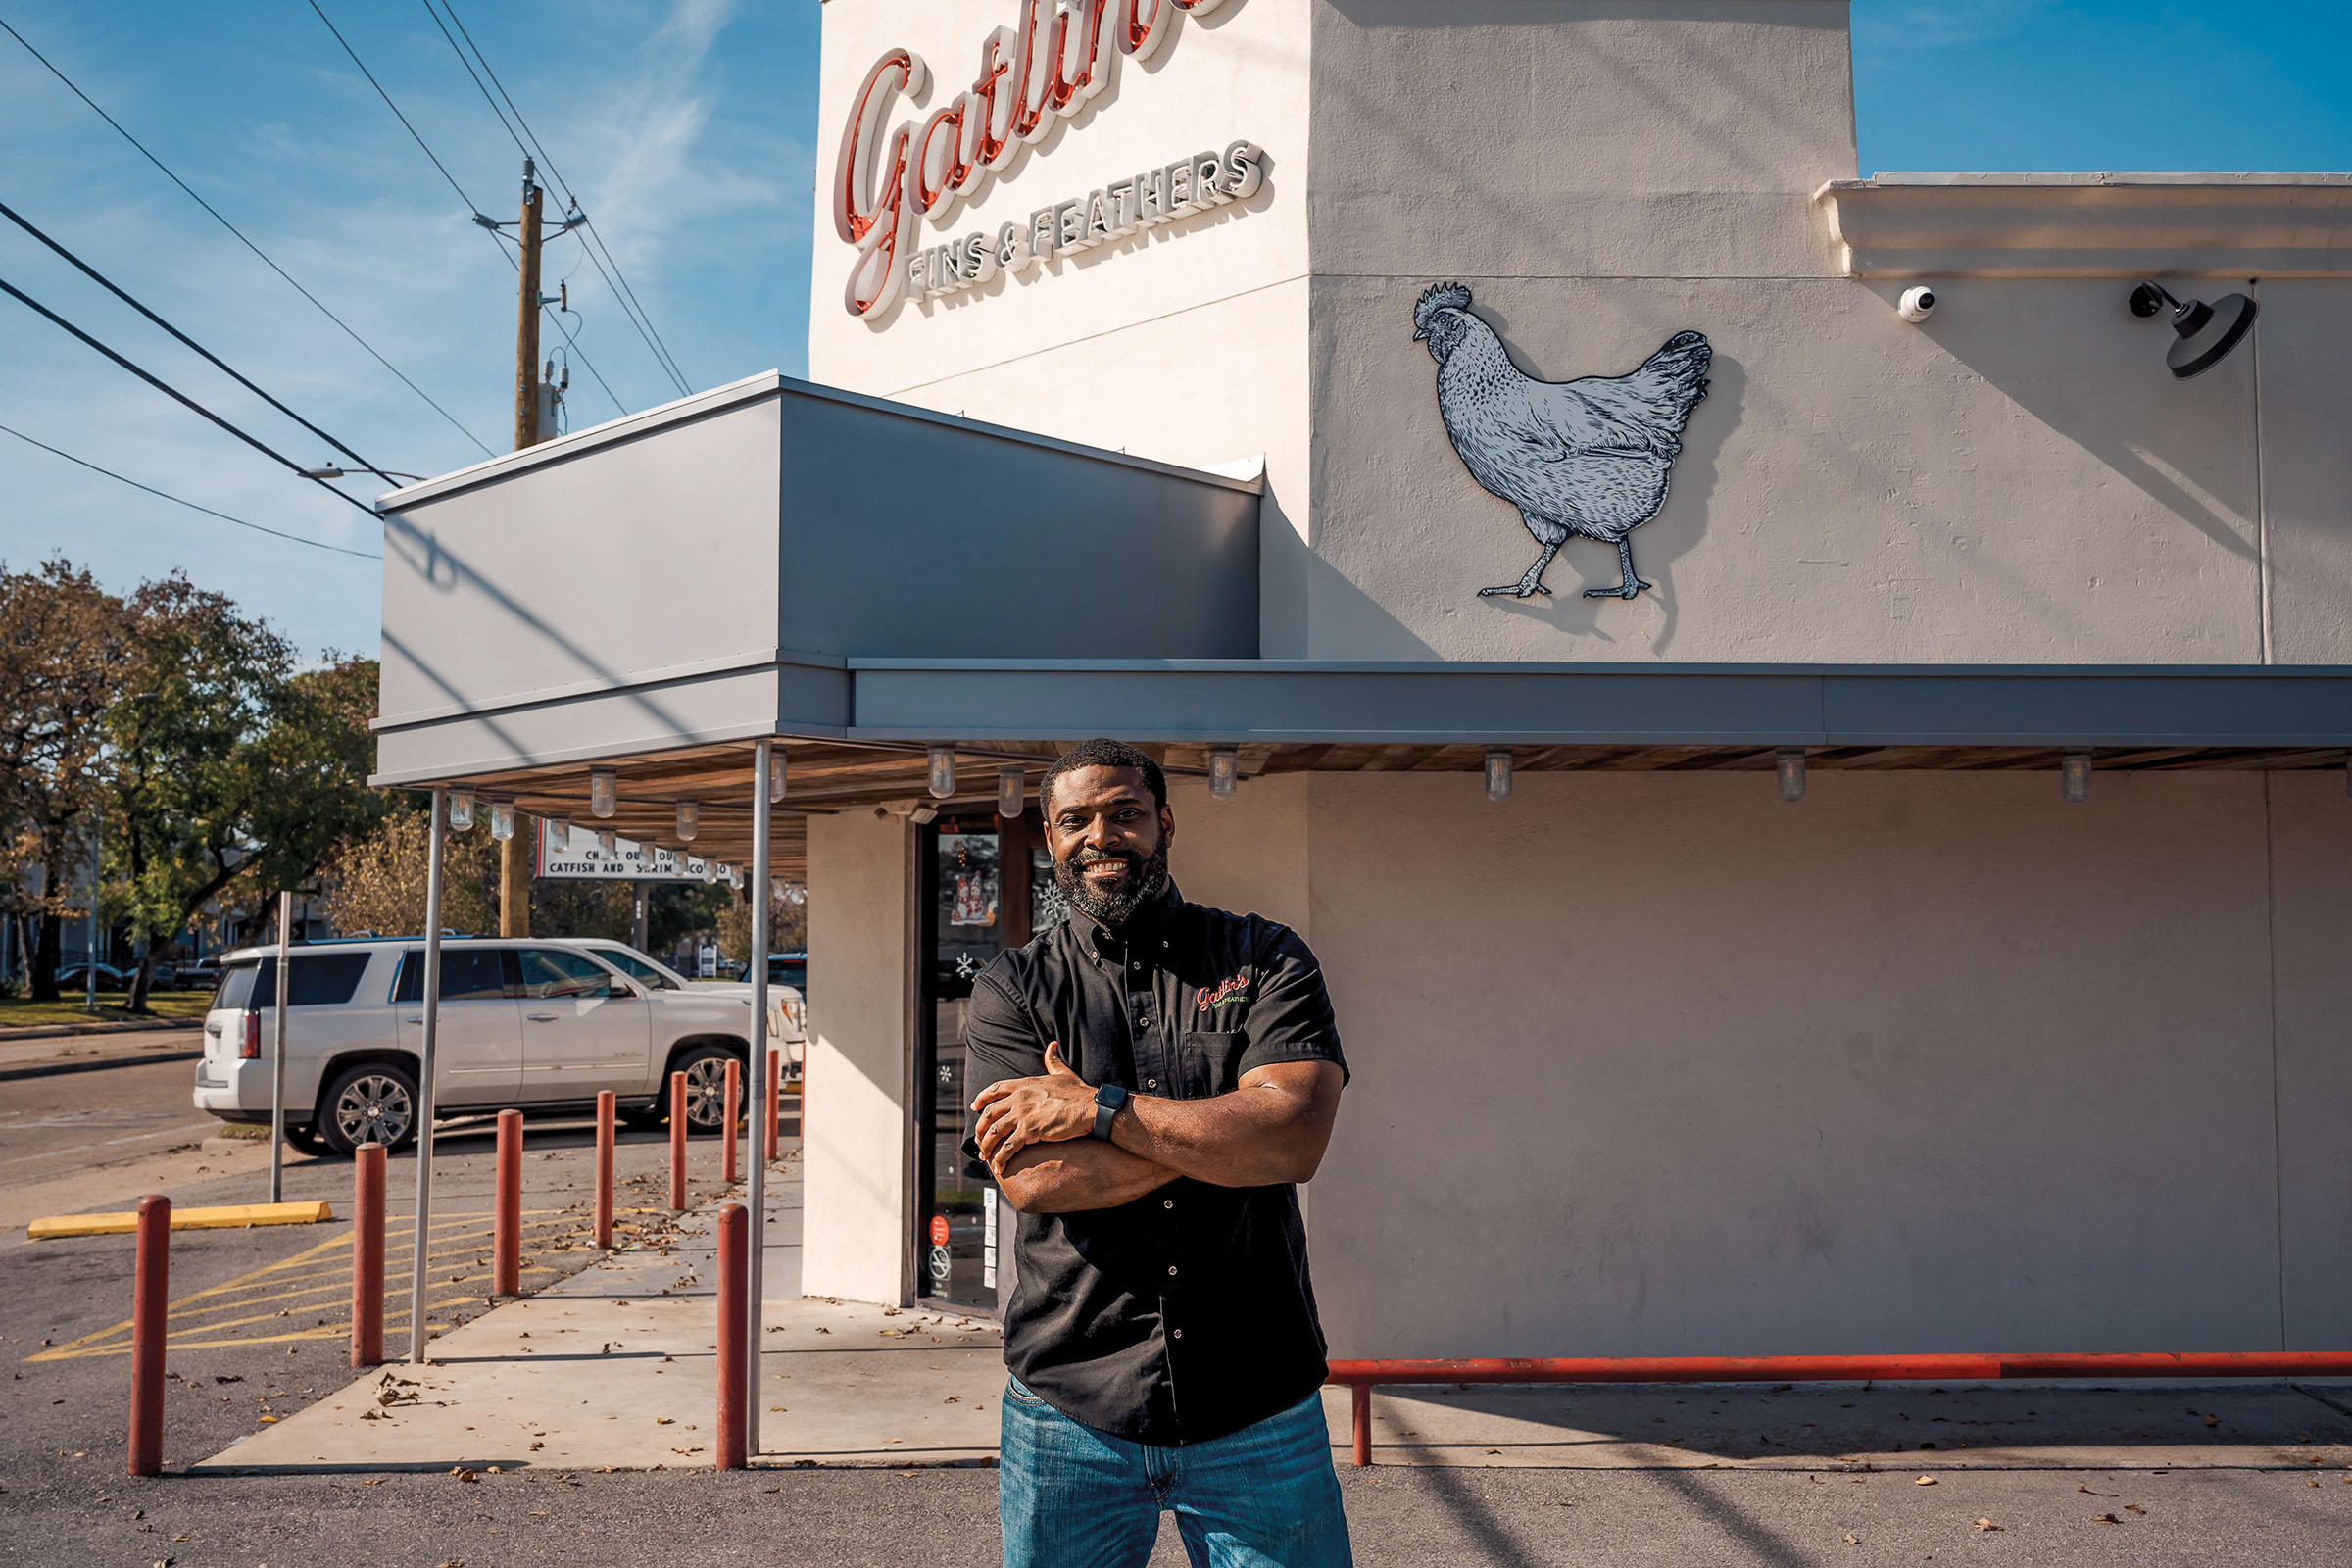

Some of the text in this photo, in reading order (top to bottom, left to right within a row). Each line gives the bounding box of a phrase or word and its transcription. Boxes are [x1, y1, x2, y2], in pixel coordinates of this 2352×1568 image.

[903, 139, 1263, 303] FINS & FEATHERS
[549, 862, 726, 874] CATFISH AND SRIM COO
[626, 851, 641, 860] OU
[659, 852, 673, 860] OU
[1197, 974, 1250, 1012] Gatlin's
